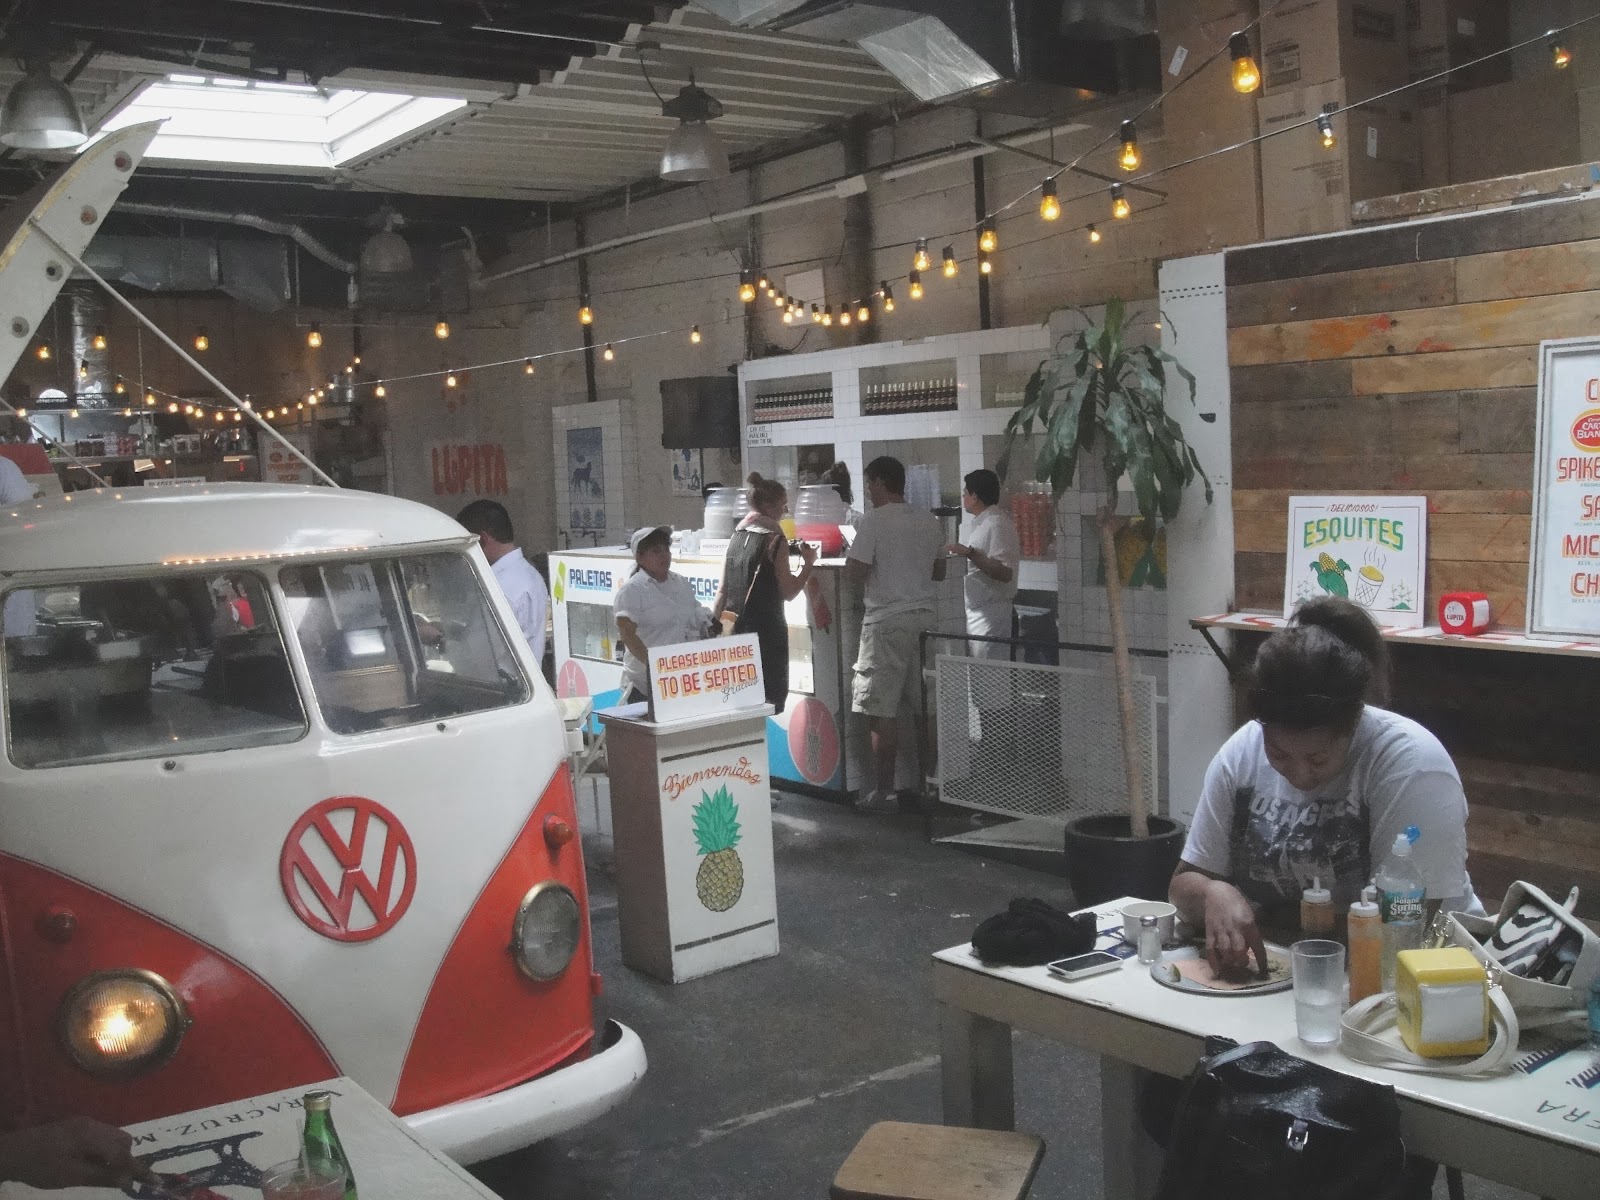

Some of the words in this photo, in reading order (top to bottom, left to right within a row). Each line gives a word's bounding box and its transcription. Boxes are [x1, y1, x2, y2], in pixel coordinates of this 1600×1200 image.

[1586, 378, 1600, 403] C
[1556, 457, 1600, 481] SPIKE
[1303, 516, 1405, 552] ESQUITES
[1562, 534, 1600, 558] MIC
[569, 568, 613, 588] PALETAS
[1571, 572, 1600, 597] CH
[657, 652, 699, 672] PLEASE
[700, 648, 727, 665] WAIT
[728, 644, 754, 661] HERE
[658, 676, 679, 700] TO
[681, 672, 701, 697] BE
[703, 663, 758, 691] SEATED
[662, 756, 763, 800] Bienvenidos
[1390, 903, 1423, 916] Spring
